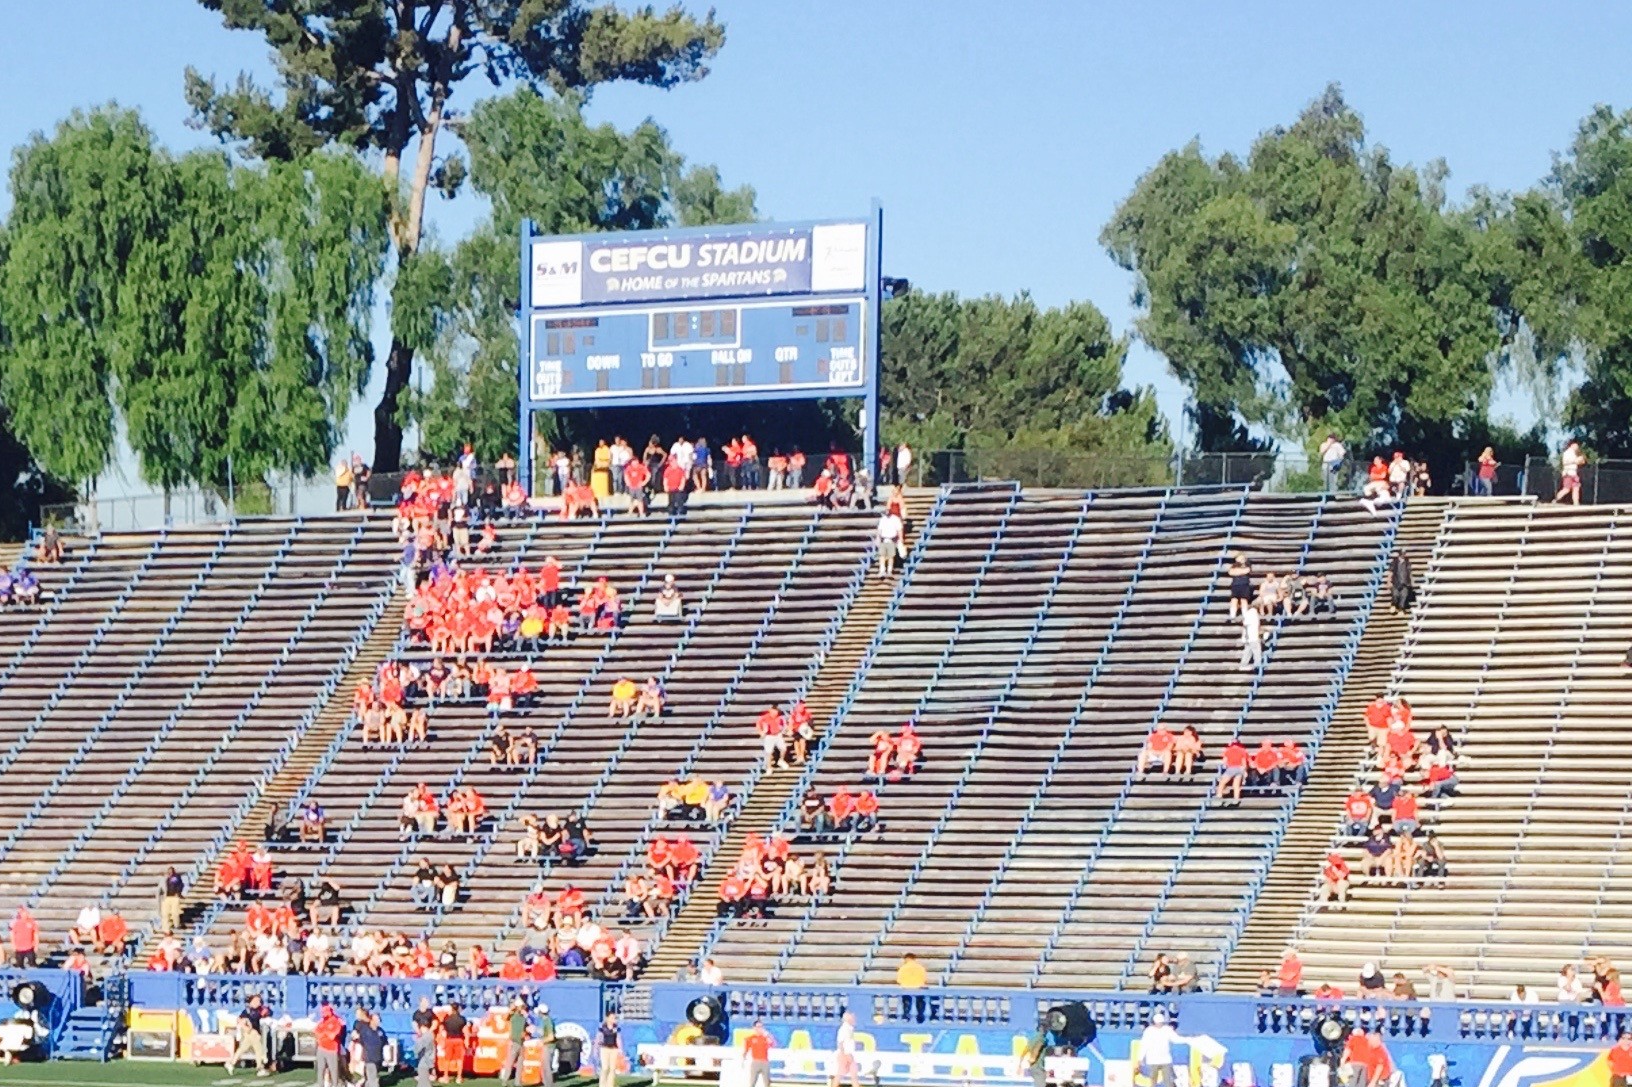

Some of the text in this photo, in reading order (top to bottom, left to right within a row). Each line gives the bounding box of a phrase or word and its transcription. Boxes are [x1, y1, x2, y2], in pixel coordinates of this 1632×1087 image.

[589, 244, 691, 273] CEFCU
[697, 238, 808, 268] STADIUM
[621, 275, 663, 292] HOME
[681, 276, 701, 288] THE
[701, 269, 771, 287] SPARTANS
[587, 354, 620, 371] DOWN
[640, 352, 673, 368] TO GO
